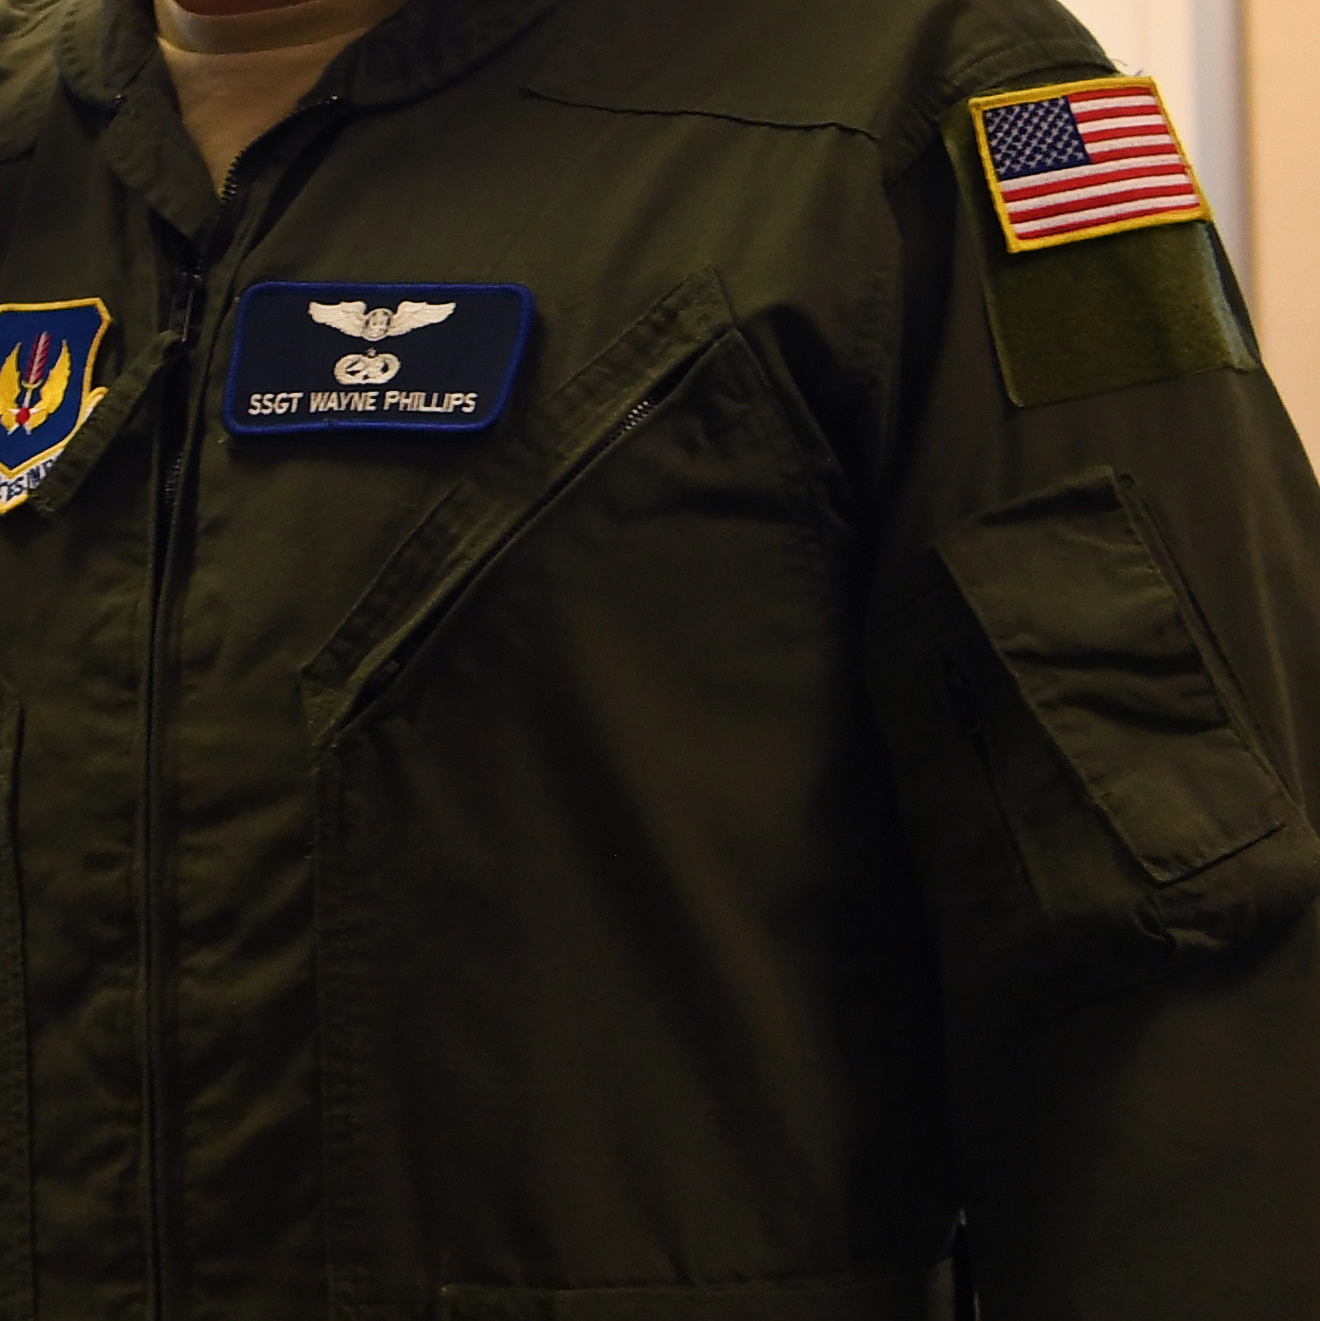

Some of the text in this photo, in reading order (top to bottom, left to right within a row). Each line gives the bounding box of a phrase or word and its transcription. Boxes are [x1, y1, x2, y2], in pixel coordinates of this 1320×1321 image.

[248, 390, 479, 416] SSGT WAYNE PHILLIPS
